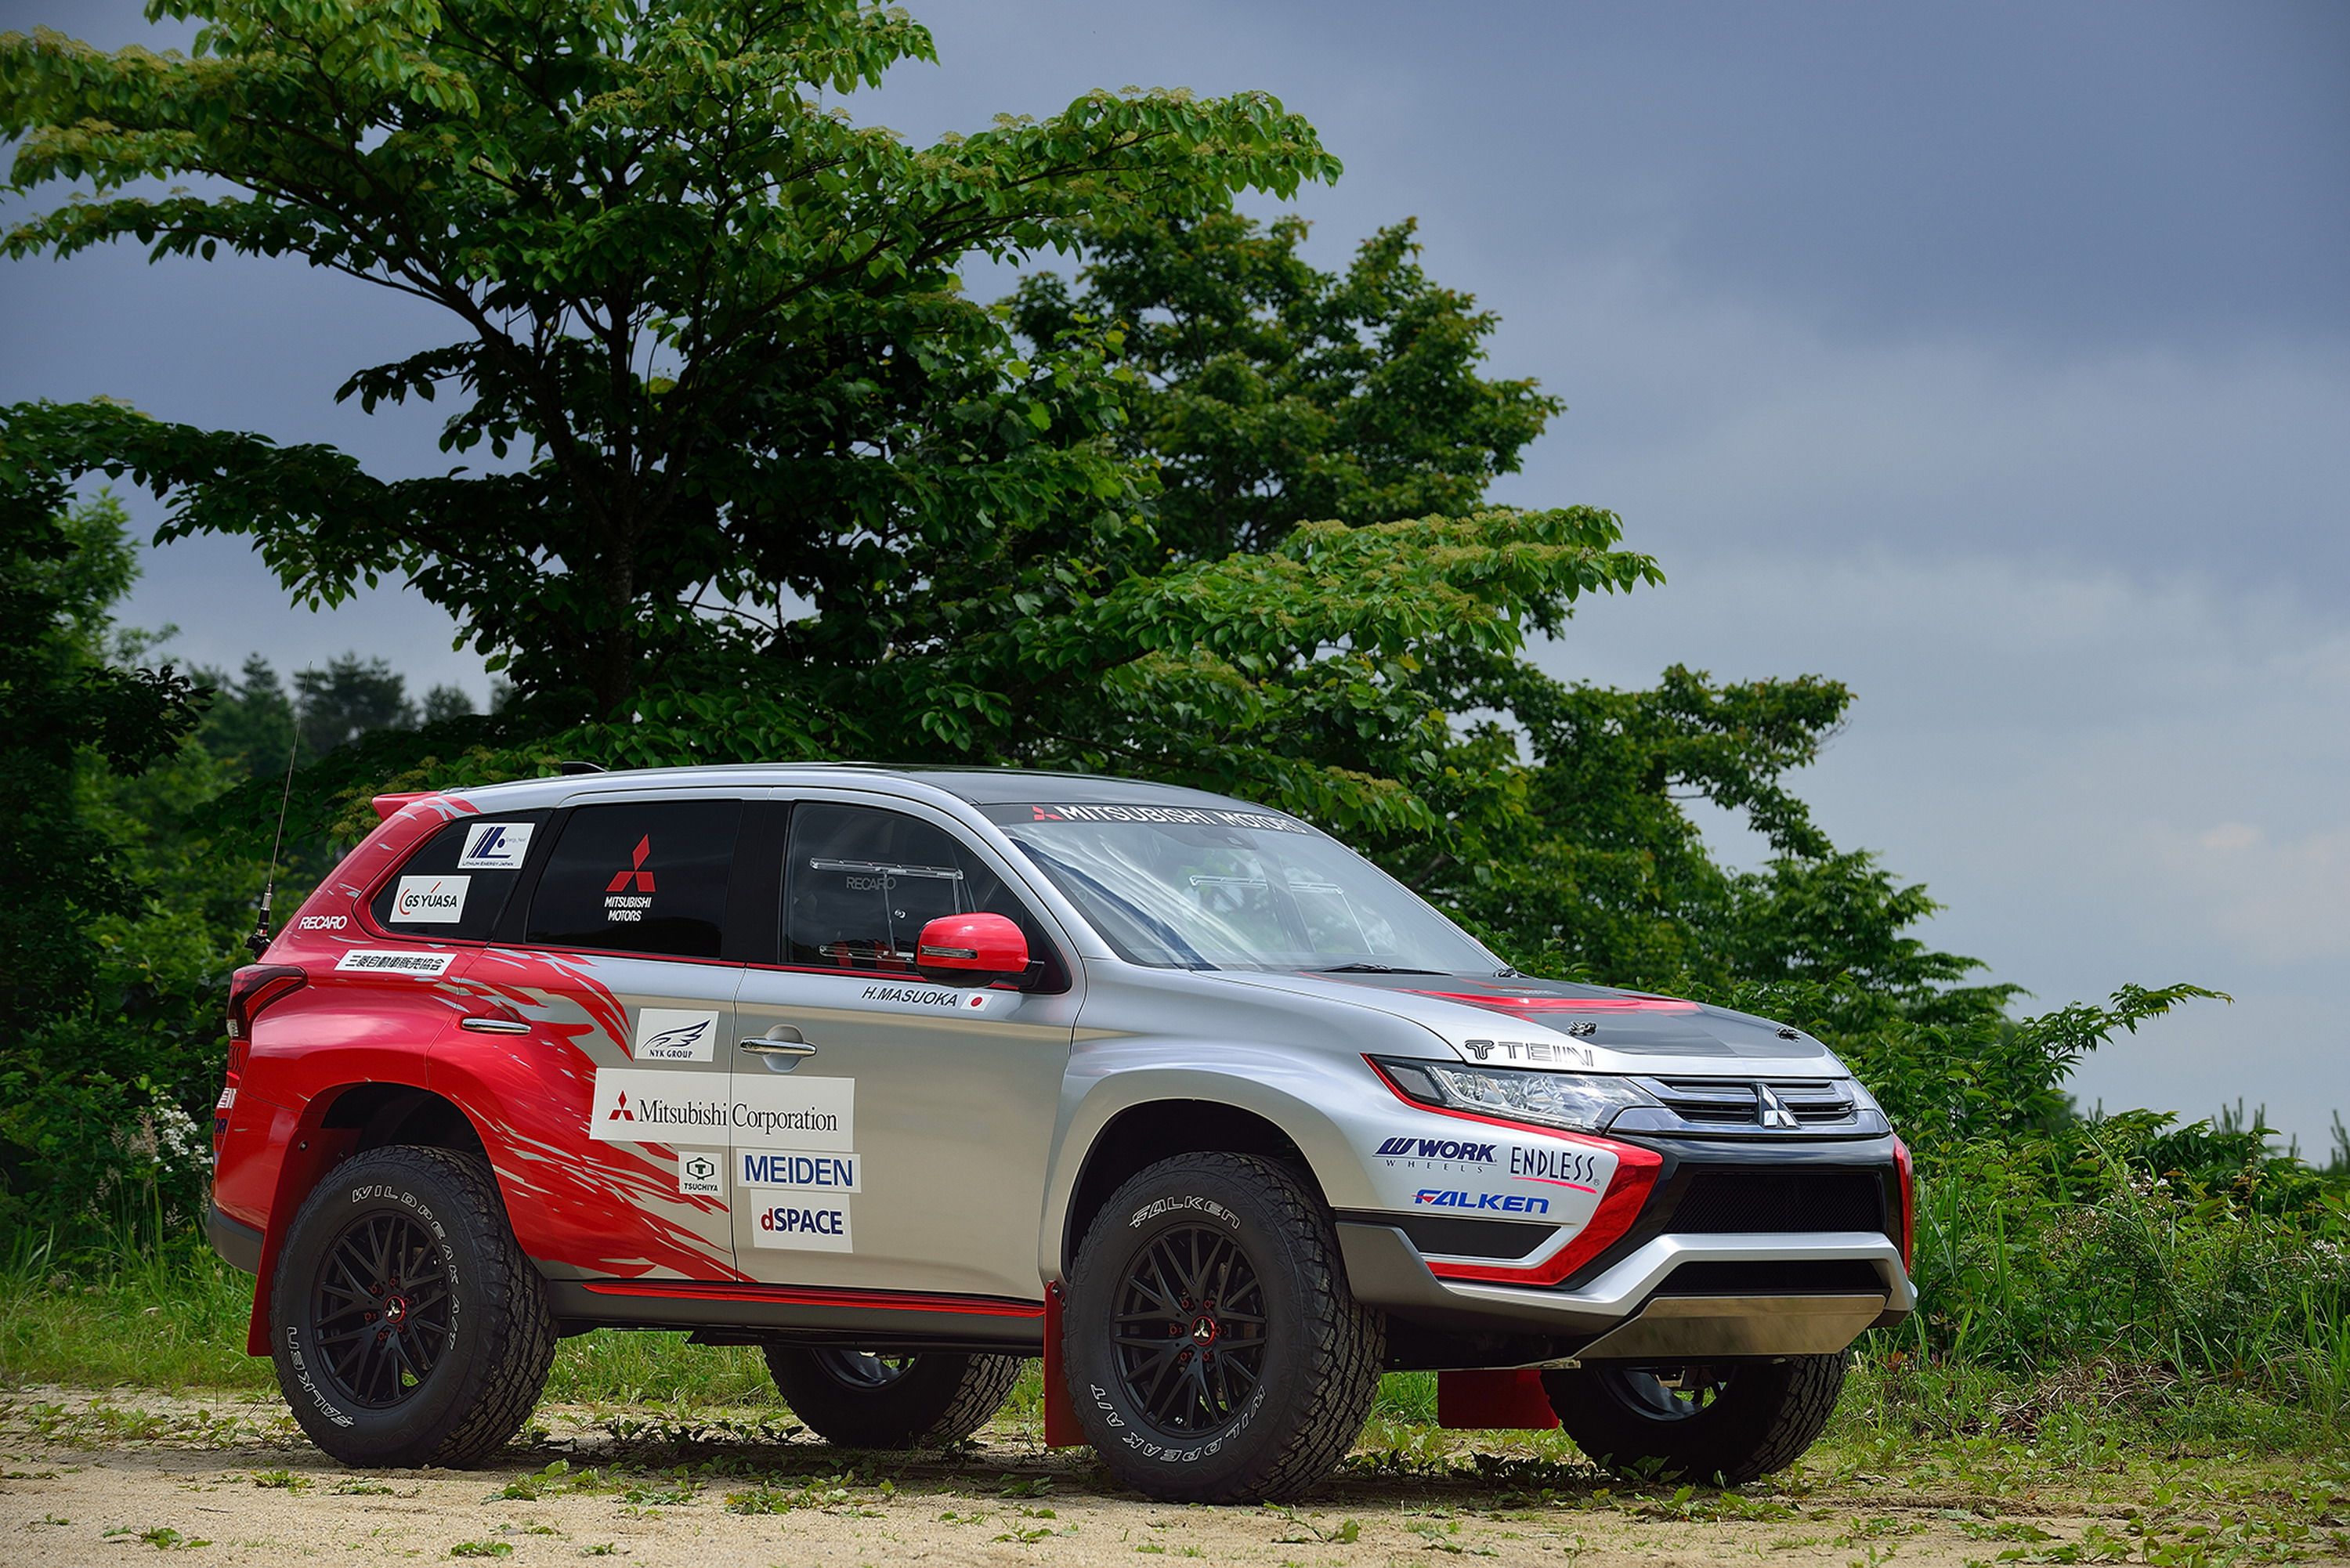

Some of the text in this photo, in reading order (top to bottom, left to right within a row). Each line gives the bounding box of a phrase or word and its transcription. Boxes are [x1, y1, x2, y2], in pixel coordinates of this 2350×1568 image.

[1054, 805, 1218, 825] MITSUBISHI
[404, 894, 457, 908] GS YUASA
[604, 896, 652, 908] MITSUBISHI
[298, 916, 348, 930] RECARO
[608, 910, 642, 922] MOTORS
[861, 986, 959, 1006] H.MASUOKA
[667, 1050, 693, 1059] GROUP
[638, 1098, 838, 1136] Mitsubishi Corporation
[744, 1154, 853, 1187] MEIDEN
[1509, 1146, 1596, 1183] ENDLESS
[684, 1183, 718, 1191] TSUCHIYA
[1129, 1195, 1241, 1230] FALKEN
[1411, 1189, 1549, 1214] FALKEN
[760, 1207, 844, 1235] dSPACE
[352, 1185, 459, 1284] WILDPEAK
[287, 1327, 354, 1427] FALKEN
[1122, 1385, 1267, 1462] WILDPEAK
